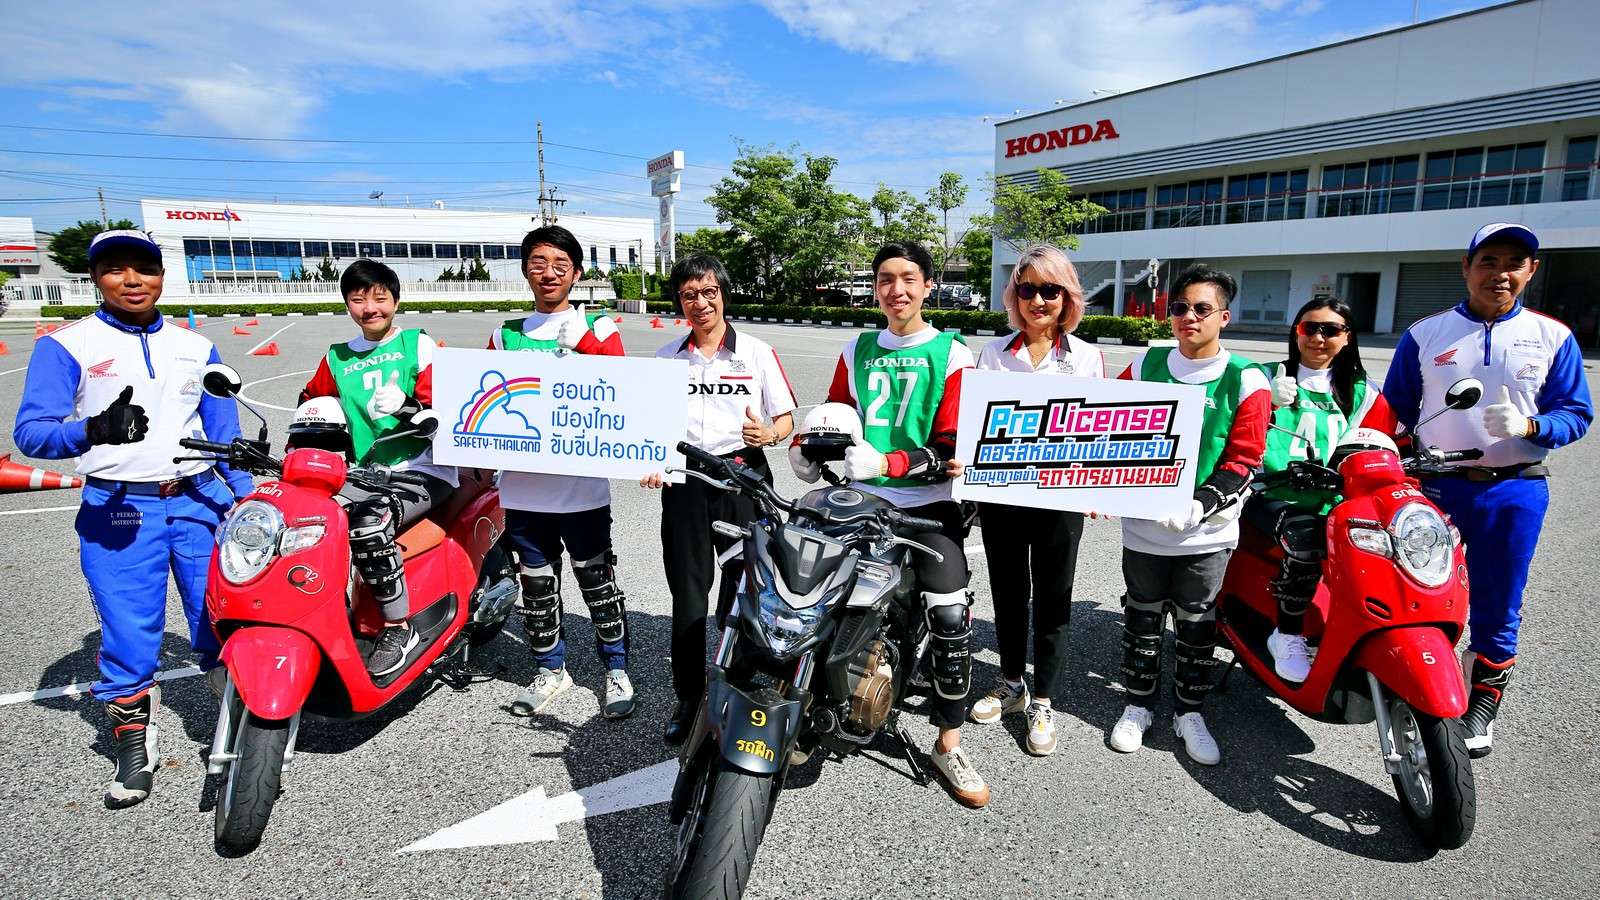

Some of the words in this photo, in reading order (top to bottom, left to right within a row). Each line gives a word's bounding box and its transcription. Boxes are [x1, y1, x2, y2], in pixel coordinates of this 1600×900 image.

[1005, 119, 1120, 158] HONDA
[648, 156, 673, 173] HONDA
[166, 210, 242, 221] HONDA
[343, 352, 405, 376] HONDA
[863, 356, 931, 369] HONDA
[552, 378, 616, 402] ฮอนด้า
[688, 384, 752, 395] ONDA
[866, 371, 919, 427] 27
[305, 407, 319, 415] 35
[551, 405, 625, 431] เมืองไทย
[989, 407, 1040, 435] Pre
[1049, 405, 1169, 433] License
[453, 435, 541, 453] SAFETY-THAILAND
[550, 429, 667, 461] ขับขี่ปลอดภัย
[274, 656, 287, 669] 7
[1422, 651, 1436, 664] 5
[750, 709, 767, 727] 9
[736, 739, 774, 762] รถฝึก
